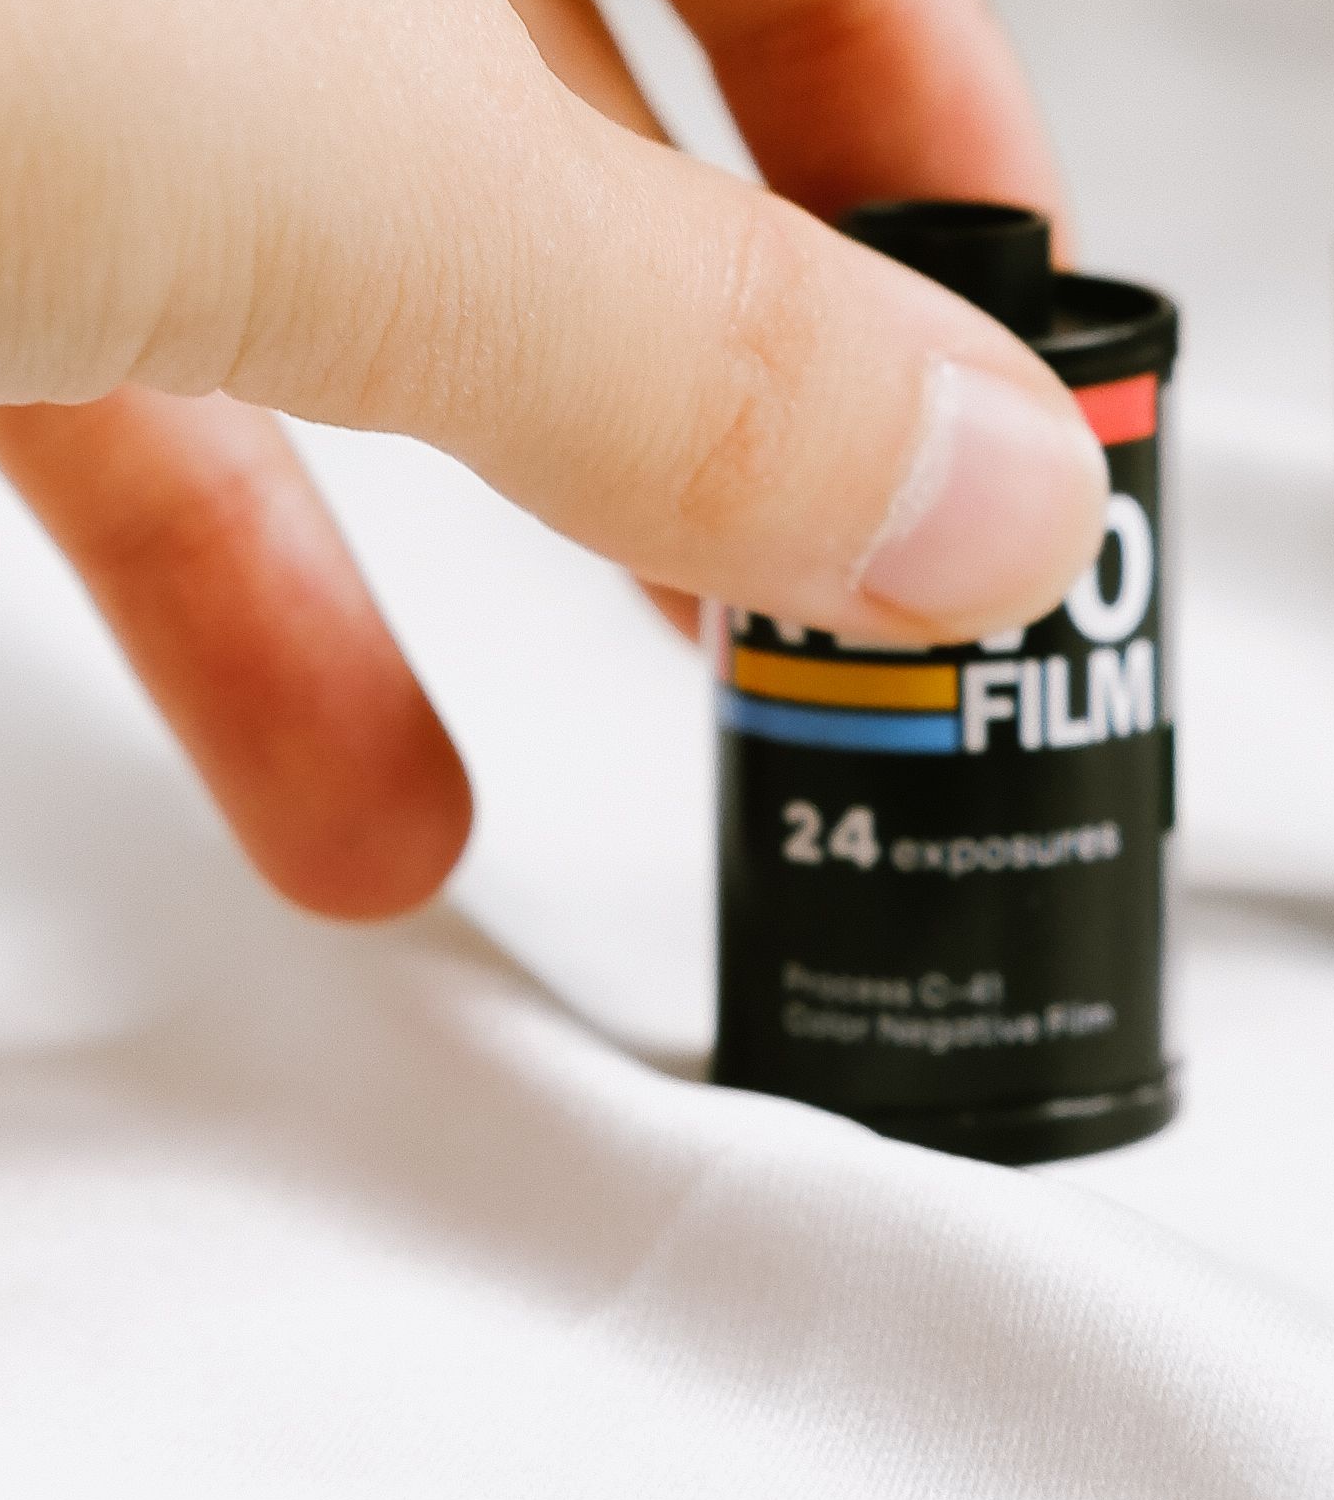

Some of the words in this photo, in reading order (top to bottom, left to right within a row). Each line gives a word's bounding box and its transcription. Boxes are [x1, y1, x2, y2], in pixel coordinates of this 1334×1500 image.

[964, 639, 1156, 752] FILM
[781, 801, 880, 870] 24
[890, 820, 1123, 878] exposures
